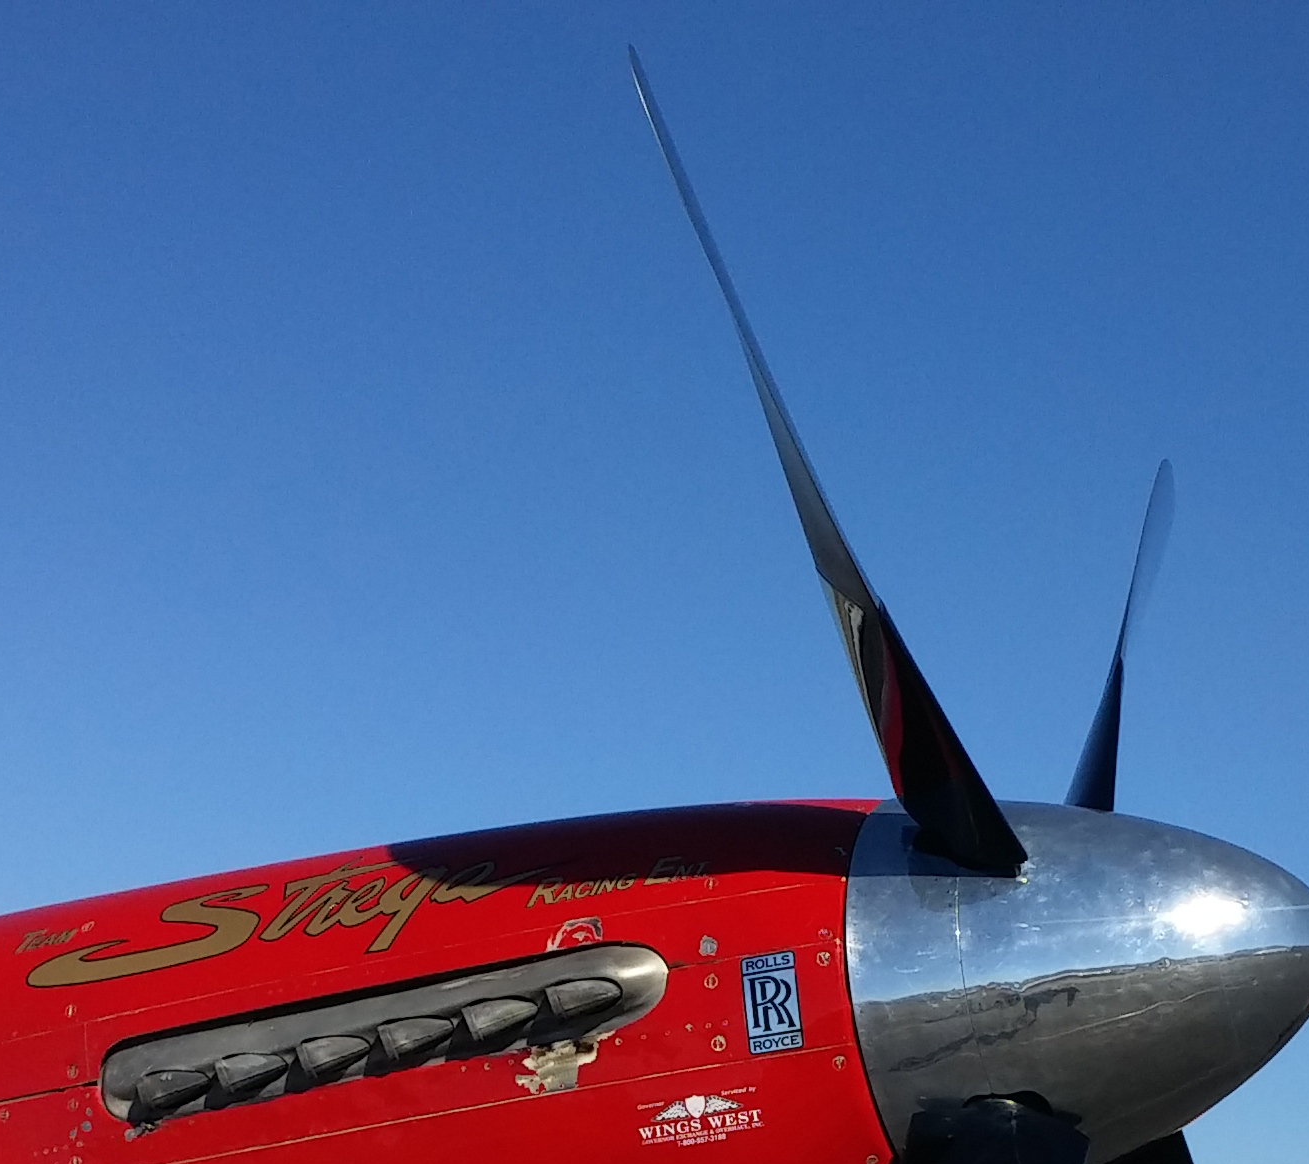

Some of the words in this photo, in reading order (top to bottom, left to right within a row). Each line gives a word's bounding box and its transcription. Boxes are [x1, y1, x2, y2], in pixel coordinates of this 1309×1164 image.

[526, 873, 637, 909] RACING
[26, 856, 559, 988] Strega
[745, 954, 791, 972] ROLLS
[752, 1034, 801, 1052] ROYCE
[638, 1119, 702, 1140] WINGS
[707, 1109, 762, 1129] WEST
